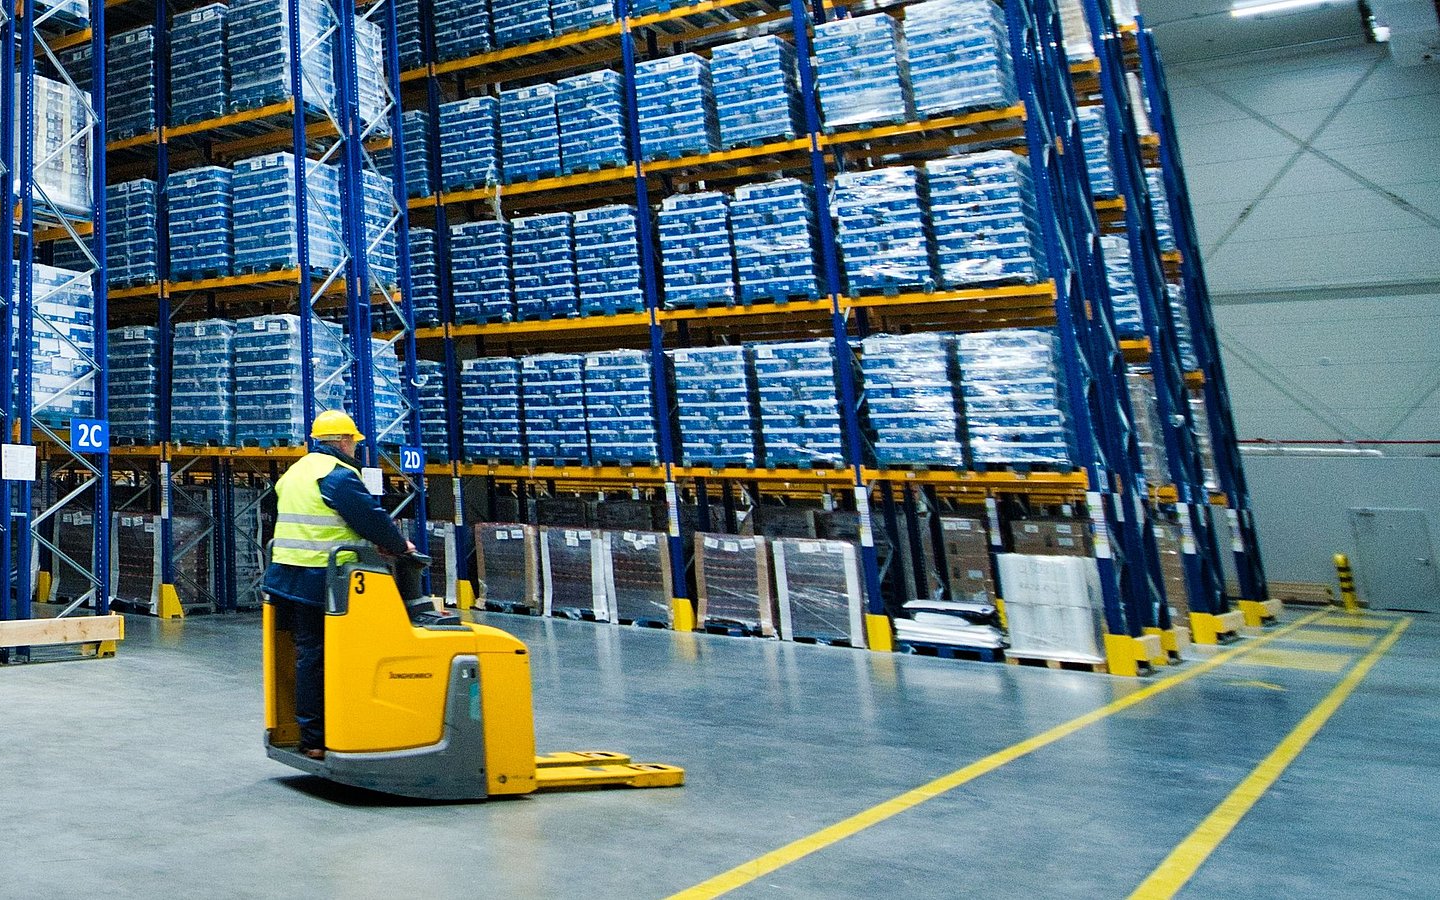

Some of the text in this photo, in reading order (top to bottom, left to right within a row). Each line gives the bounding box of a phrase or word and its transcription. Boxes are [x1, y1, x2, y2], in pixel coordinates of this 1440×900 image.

[78, 424, 103, 448] 2C
[404, 450, 421, 469] 2D
[354, 571, 365, 595] 3
